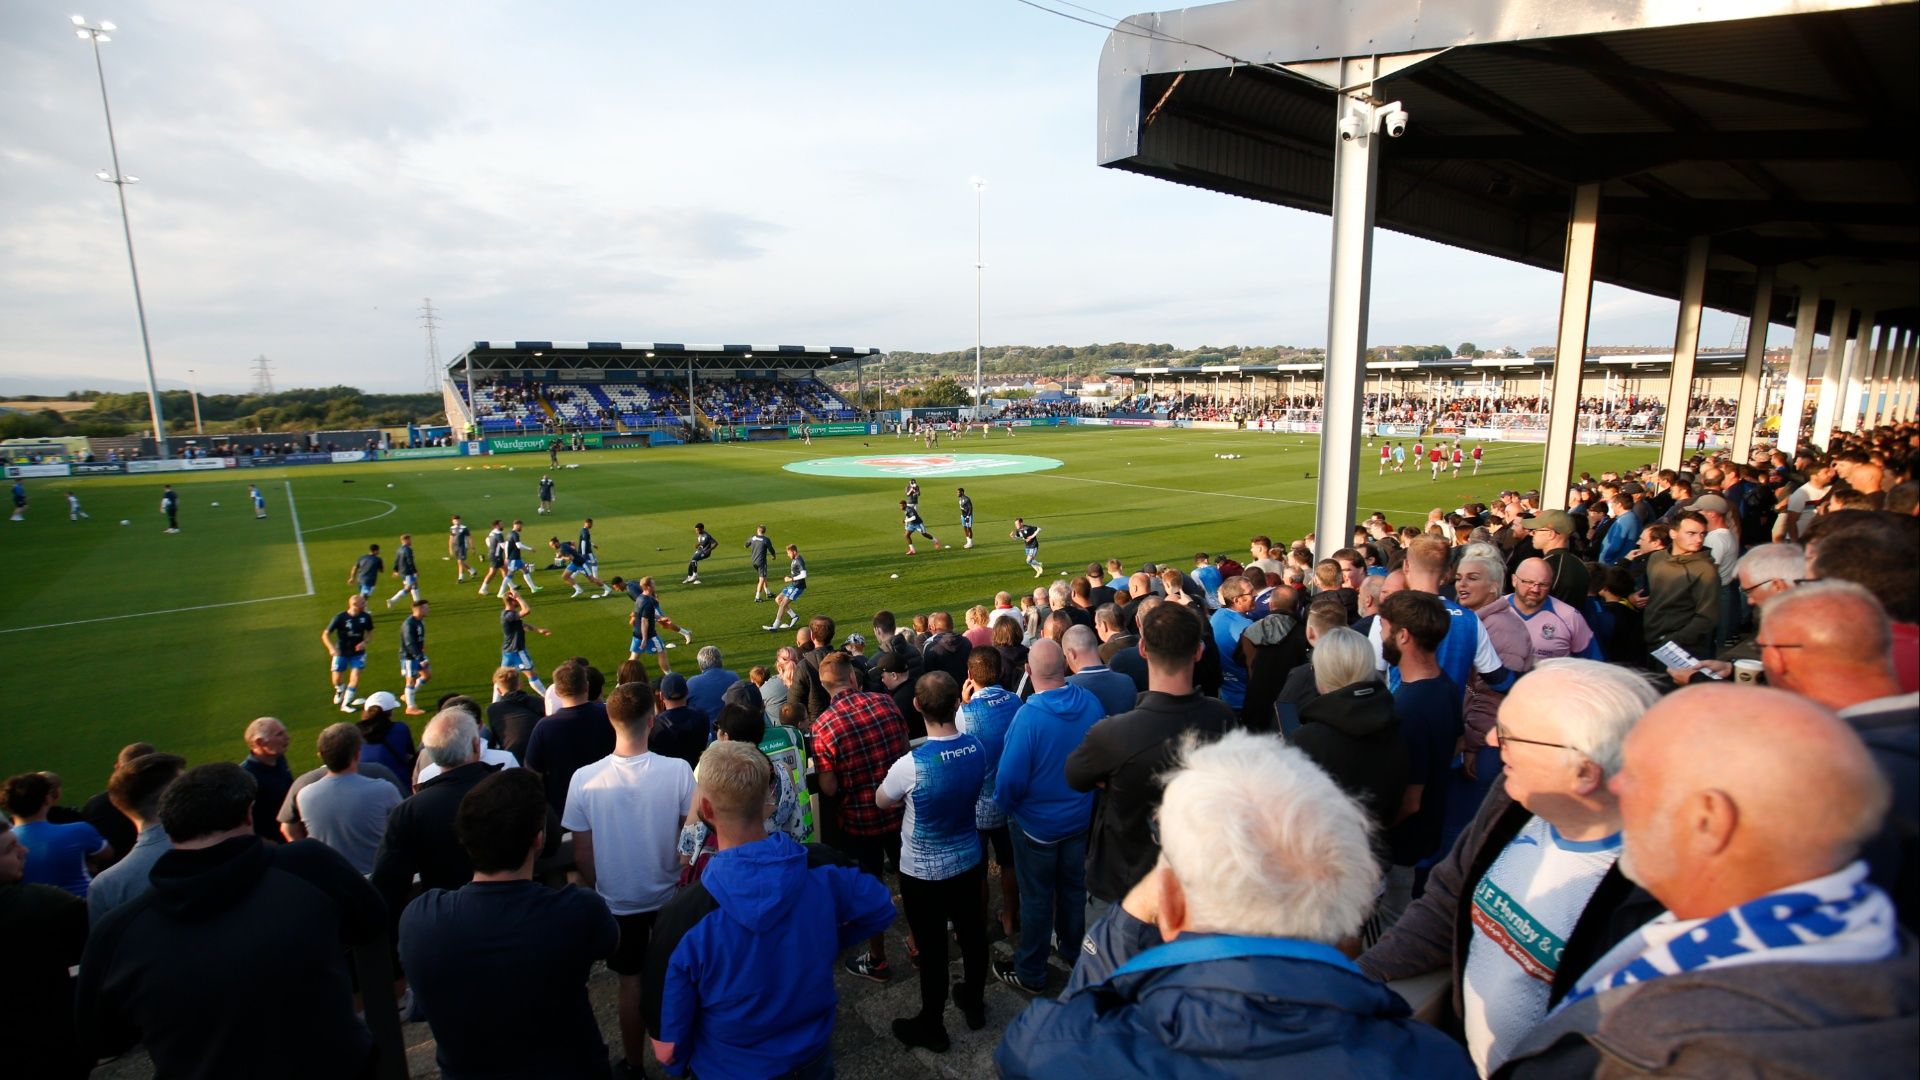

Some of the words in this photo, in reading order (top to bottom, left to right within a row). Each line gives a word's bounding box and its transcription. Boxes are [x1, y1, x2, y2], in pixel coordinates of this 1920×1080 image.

[494, 439, 544, 450] Wardgroup
[987, 694, 1010, 707] thena
[940, 744, 977, 761] thena
[1493, 895, 1540, 943] Hornby
